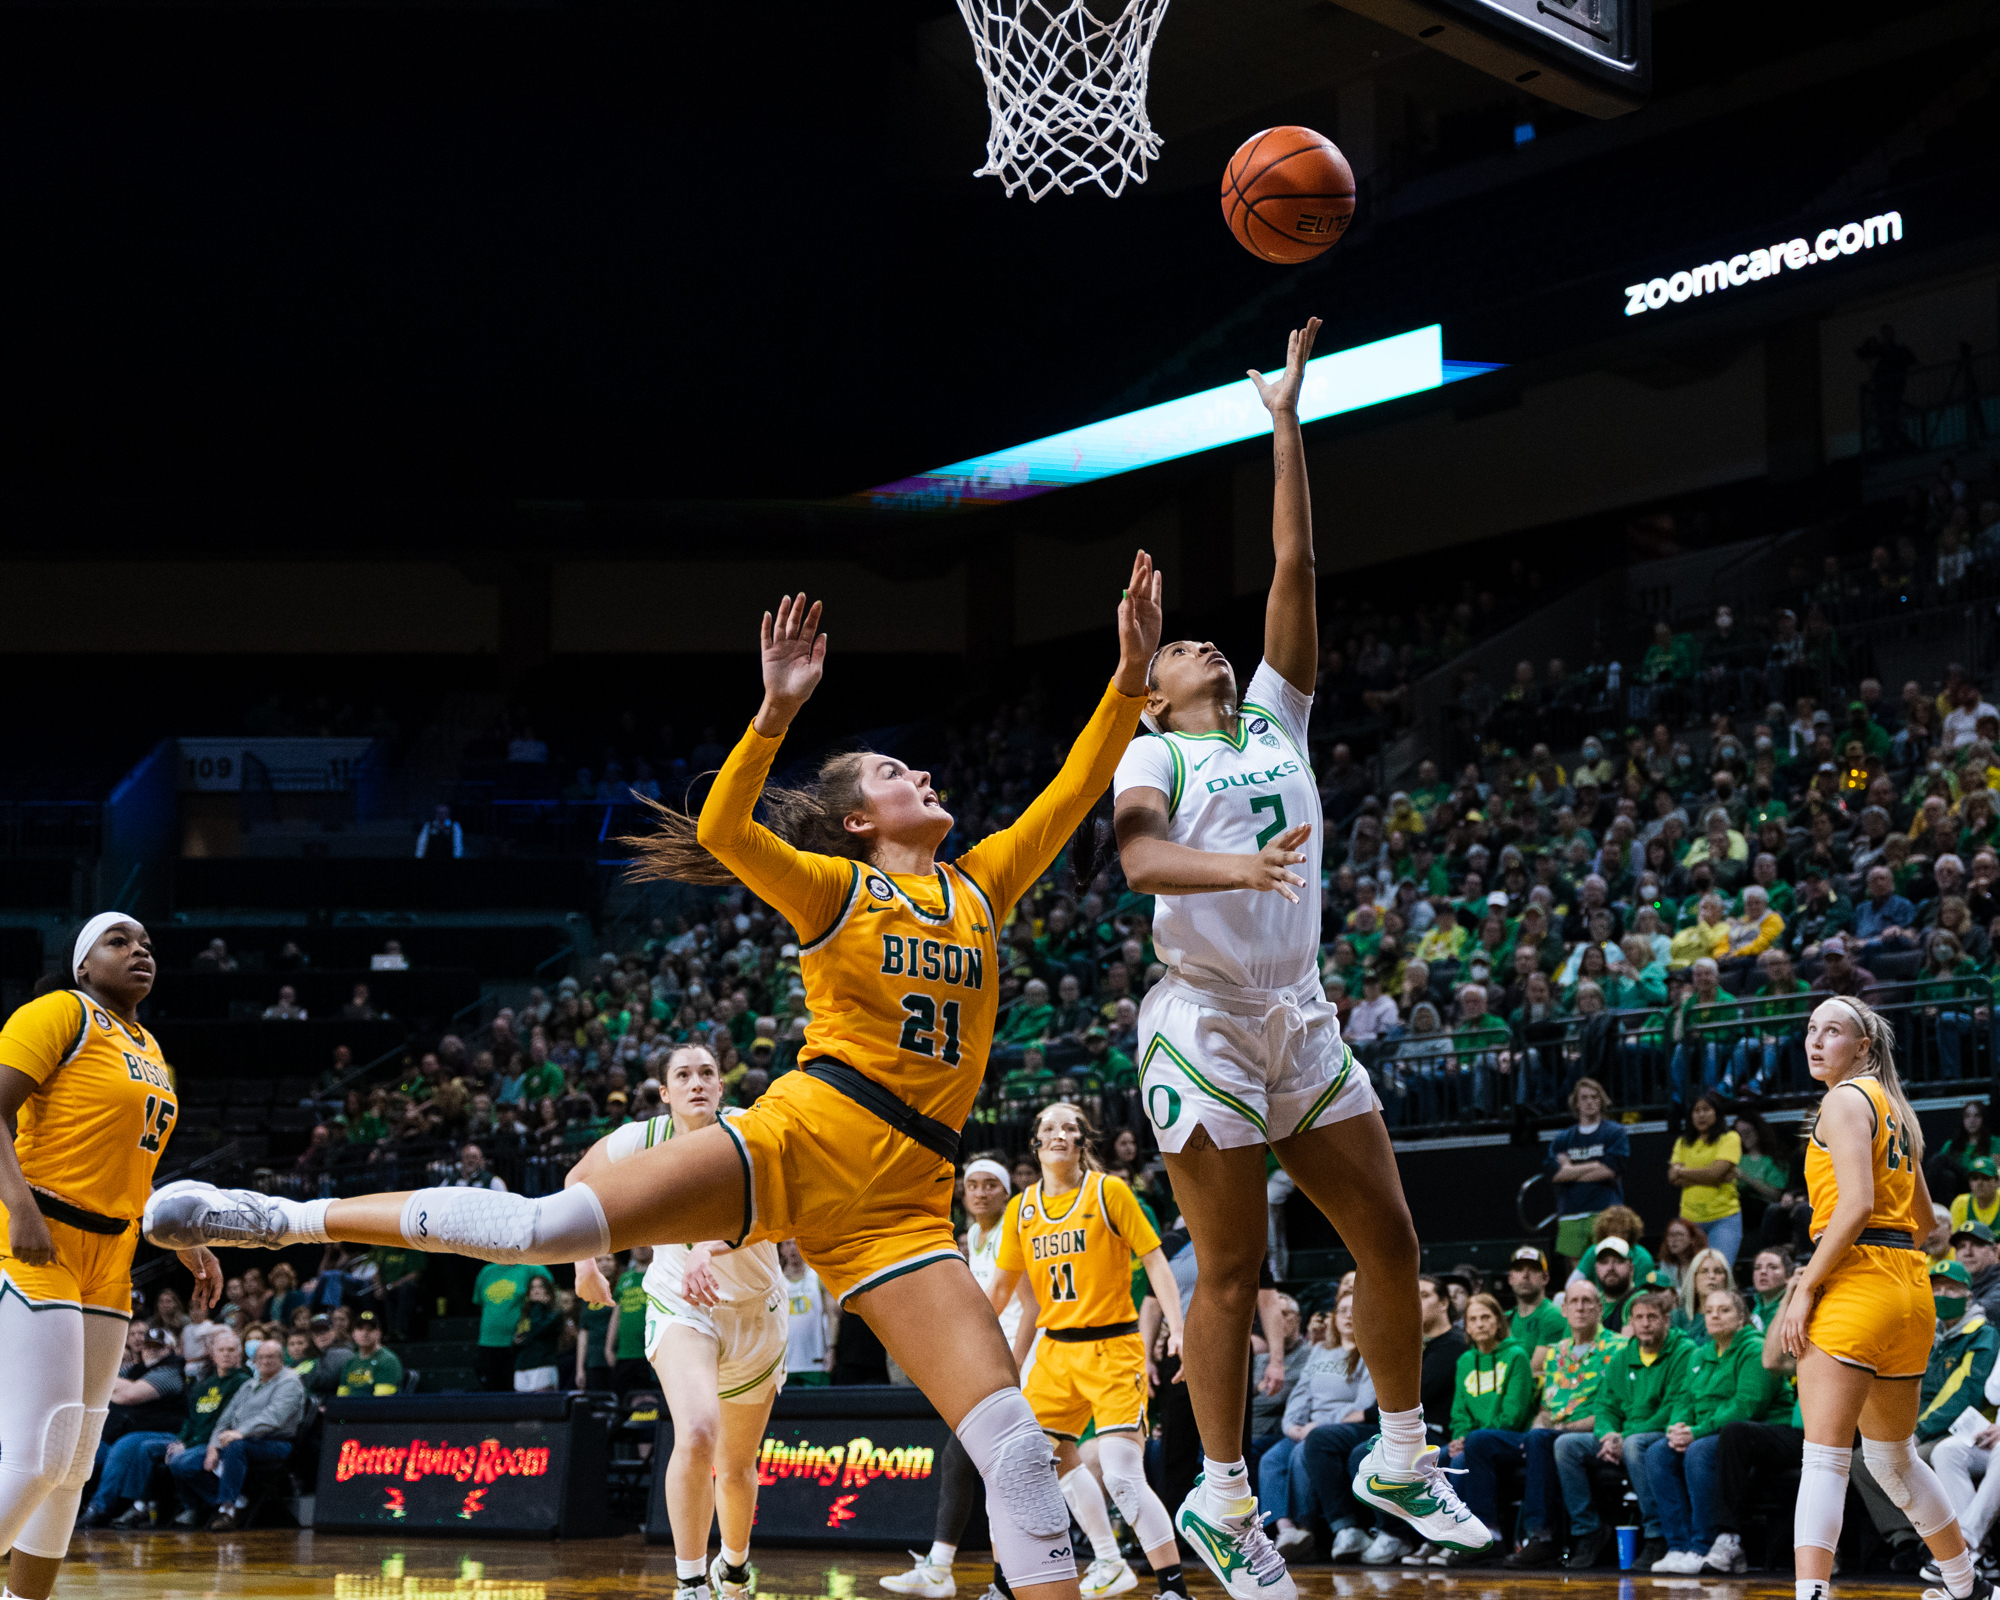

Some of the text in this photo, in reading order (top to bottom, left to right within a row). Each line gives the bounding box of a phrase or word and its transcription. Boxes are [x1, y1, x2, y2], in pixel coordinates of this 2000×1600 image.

[1296, 213, 1352, 234] ELITE
[1624, 210, 1903, 317] zoomcare.com
[186, 757, 231, 779] 109
[1205, 760, 1299, 794] DUCKS
[880, 932, 983, 990] BISON
[897, 991, 962, 1070] 21
[121, 1051, 174, 1094] BISO
[137, 1093, 176, 1155] 15
[1148, 1084, 1182, 1131] O
[1031, 1228, 1087, 1262] BISON
[1049, 1261, 1079, 1303] 11
[336, 1438, 550, 1484] Better Living Room
[758, 1437, 936, 1488] Living Room
